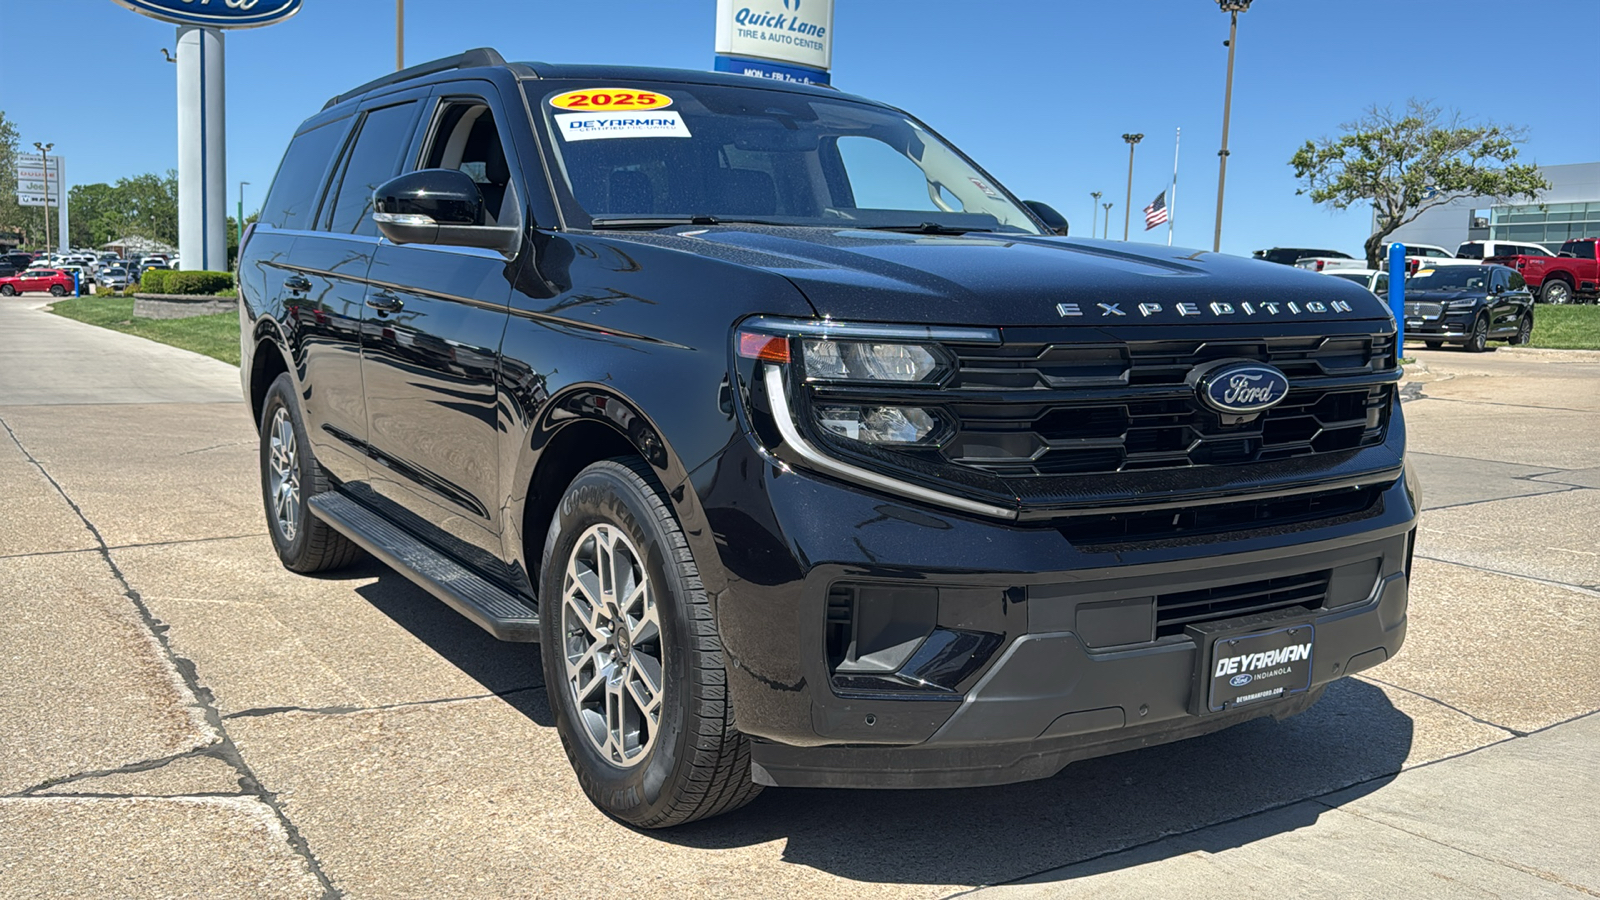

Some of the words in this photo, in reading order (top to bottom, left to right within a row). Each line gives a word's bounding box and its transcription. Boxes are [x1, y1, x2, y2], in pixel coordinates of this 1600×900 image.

[735, 8, 787, 29] Quick
[788, 16, 825, 37] Lane
[738, 29, 758, 39] TIRE
[760, 31, 767, 40] &
[768, 33, 792, 44] AUTO
[794, 38, 823, 51] CENTER
[744, 69, 763, 78] MON
[771, 72, 784, 81] FRI
[567, 94, 657, 106] 2025
[569, 119, 675, 128] DEYARMAN
[1055, 300, 1353, 318] EXPEDITION
[1223, 373, 1276, 404] Ford
[563, 485, 645, 547] GOODYEAR
[1214, 643, 1312, 677] DEYARMAN
[1253, 667, 1292, 680] INDIANOLA
[1236, 687, 1284, 703] DEYARMANFORD.COM
